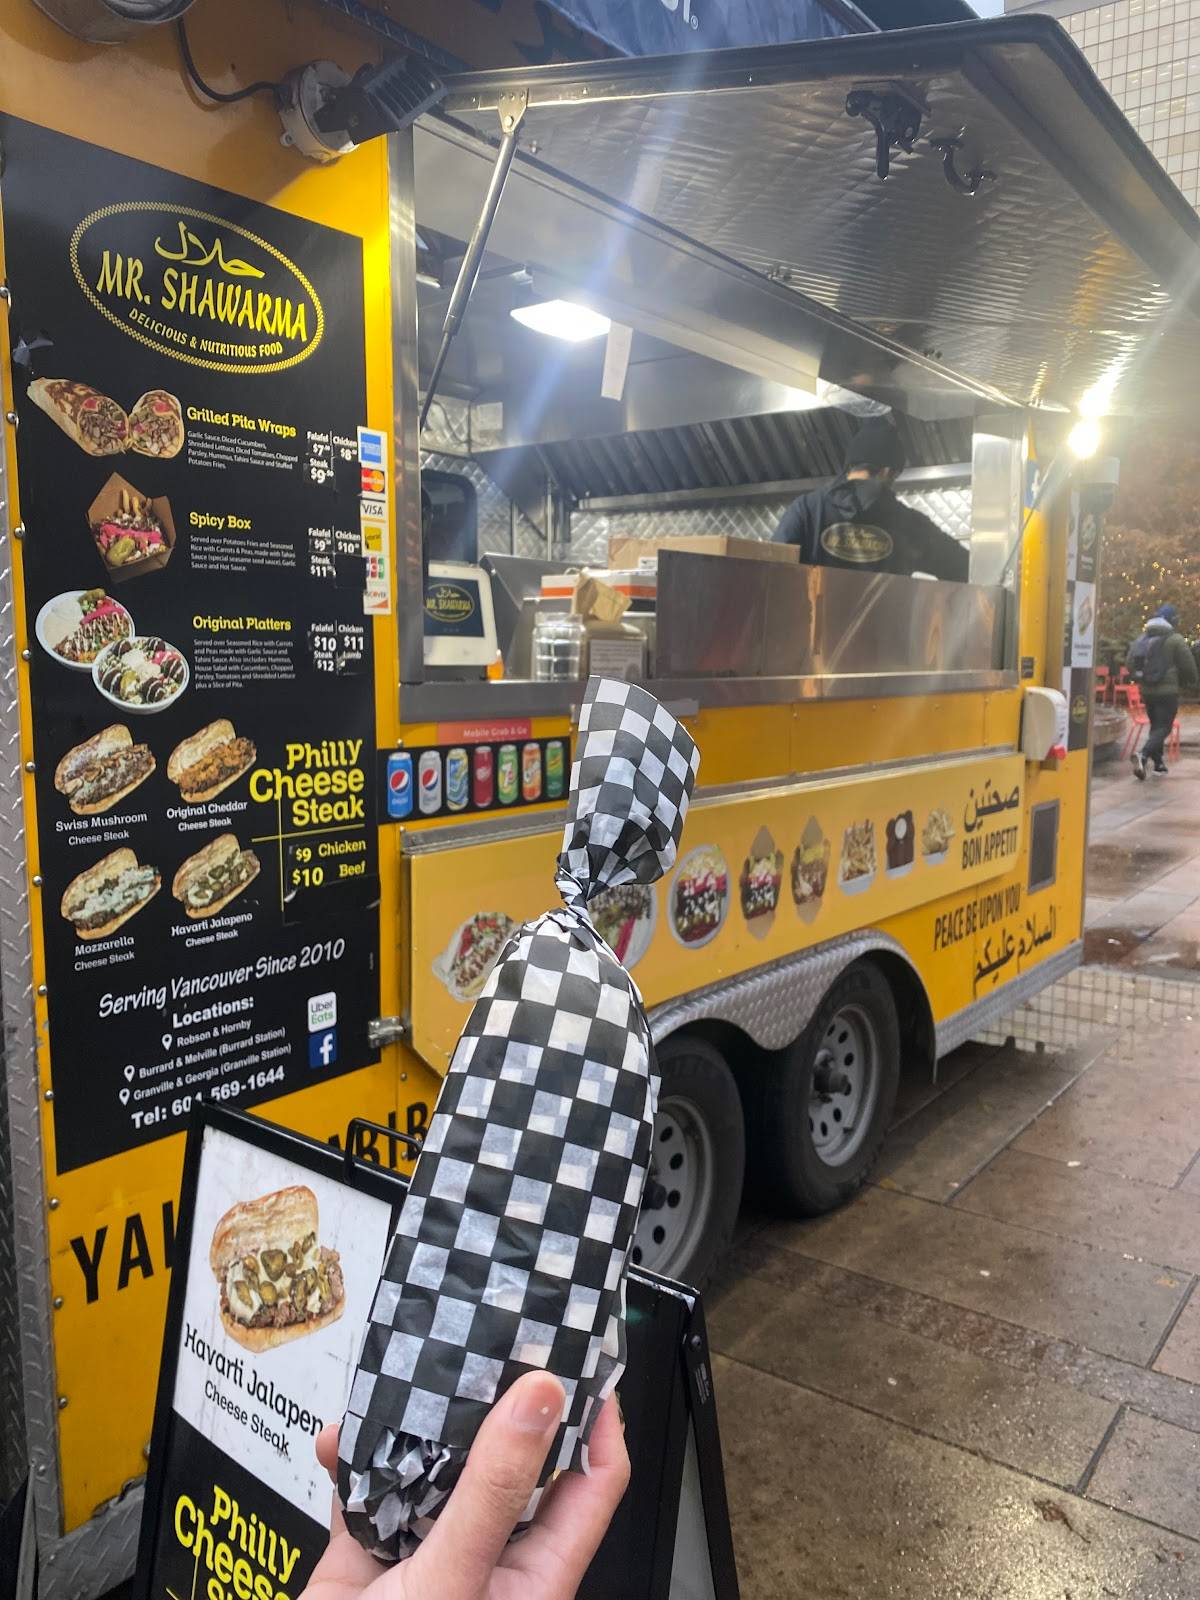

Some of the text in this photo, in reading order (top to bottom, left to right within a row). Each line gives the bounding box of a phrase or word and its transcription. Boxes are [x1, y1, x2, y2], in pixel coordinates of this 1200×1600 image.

[96, 250, 307, 342] MR. SHAWARMA
[128, 308, 283, 358] DELICIOUS & NUTRITIOUS FOOD
[187, 406, 297, 438] Grilled Pita Wraps
[190, 512, 252, 530] Spicy Box
[362, 503, 384, 516] VISA
[193, 616, 292, 632] Original Platters
[311, 623, 334, 632] Falafel
[338, 624, 364, 633] Chicken
[314, 635, 337, 652] $10
[314, 650, 333, 659] Steak
[344, 635, 364, 651] $11
[317, 660, 334, 672] $12
[464, 728, 490, 736] Mobile
[286, 738, 362, 770] Philly
[250, 768, 365, 804] Cheese
[55, 812, 148, 832] Swiss Mushroom
[166, 800, 248, 820] Original Cheddar
[292, 794, 366, 827] Steak
[178, 816, 232, 832] Cheese Steak
[68, 830, 130, 846] Cheese Steak
[962, 826, 1018, 870] BON APPETIT
[295, 840, 366, 863] $9 Chicken
[292, 860, 366, 888] $10 Beef
[171, 912, 253, 937] Havarti Jalapeno
[934, 883, 1021, 952] PEACE BE UPON YOU
[75, 936, 134, 957] Mozzarella
[185, 929, 238, 948] Cheese Steak
[74, 951, 135, 972] Cheese Steak
[98, 938, 345, 1019] Serving Vancouver Since 2010
[172, 996, 254, 1028] Locations:
[310, 1000, 334, 1014] Uber
[312, 1011, 334, 1025] Eats
[176, 1020, 251, 1048] Robson & Hornby
[139, 1026, 286, 1078] Burrard & Melville (Burrard Station)
[319, 1033, 334, 1066] f
[134, 1043, 292, 1100] Granville & Georgia (Granville Station)
[132, 1064, 285, 1129] Tel: 60569-1644
[184, 1323, 324, 1437] Havarti Jalapen
[204, 1380, 290, 1456] Cheese Steak
[210, 1484, 300, 1584] Philly
[174, 1494, 292, 1600] Chees
